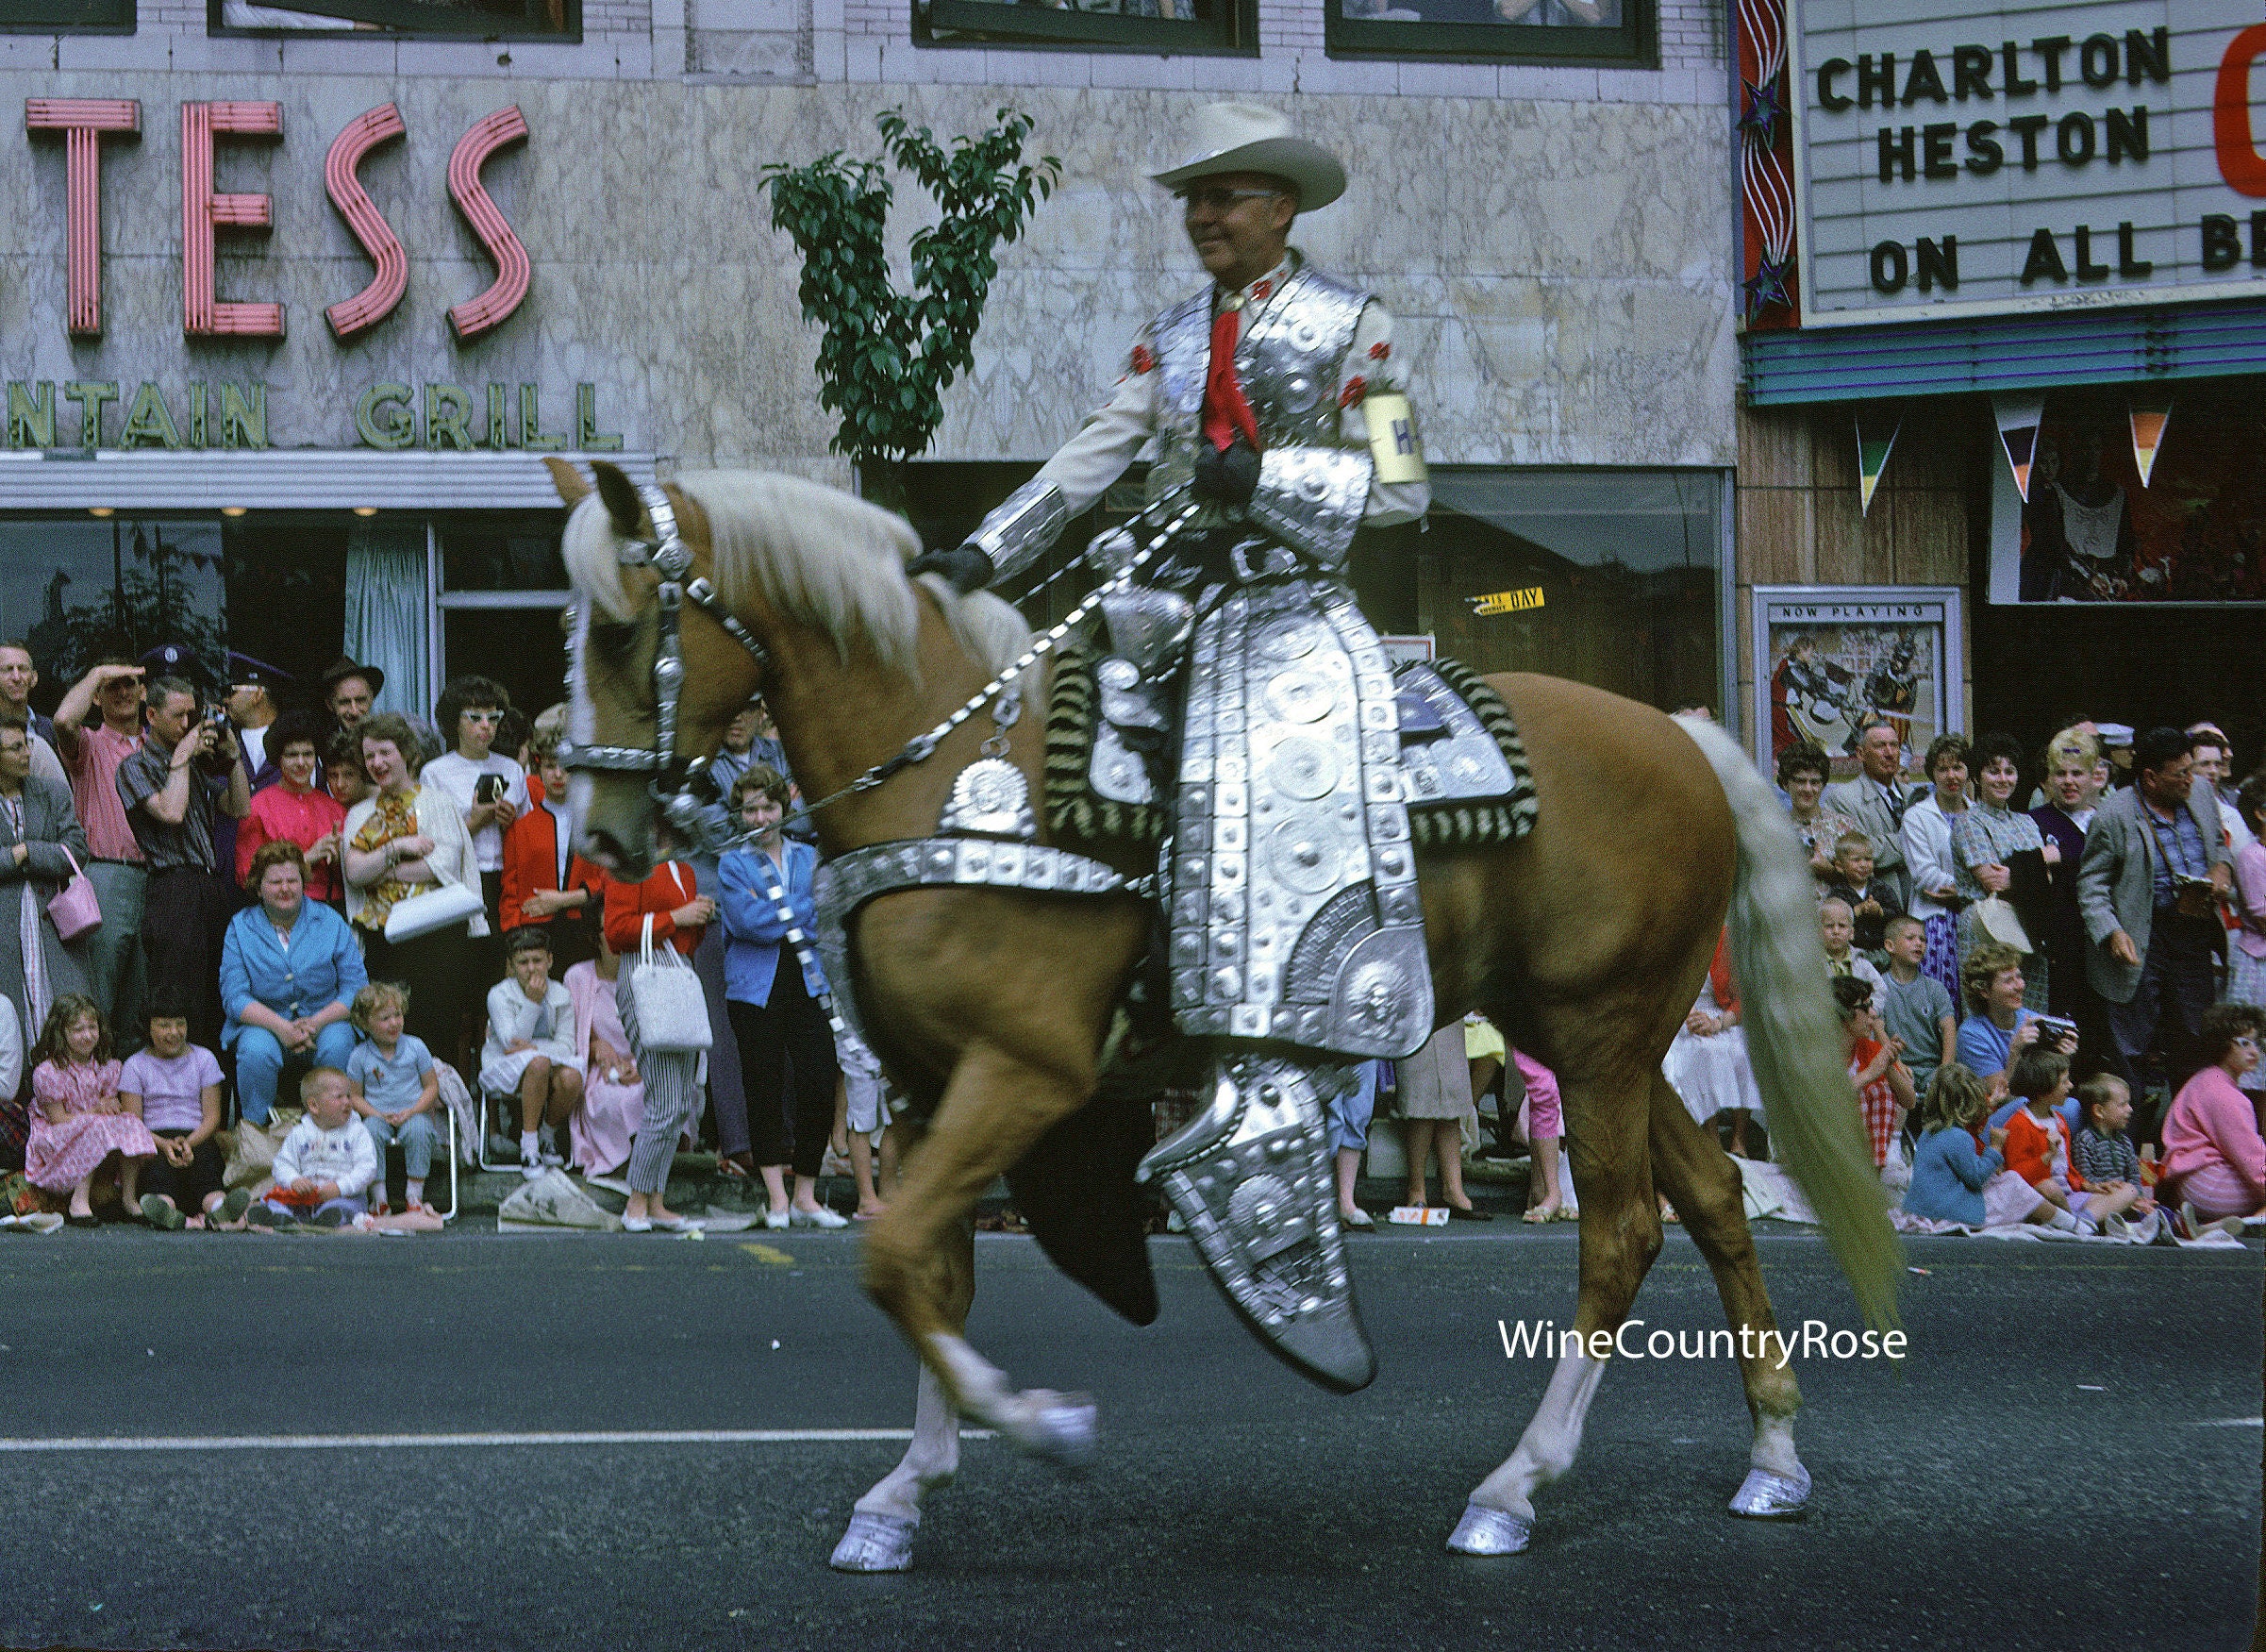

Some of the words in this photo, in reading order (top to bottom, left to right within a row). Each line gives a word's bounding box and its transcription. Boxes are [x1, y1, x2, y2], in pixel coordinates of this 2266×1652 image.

[1817, 25, 2170, 112] CHARLTON
[1878, 106, 2149, 183] HESTON
[25, 97, 531, 338] TESS
[1870, 235, 1958, 293] ON
[2020, 222, 2152, 285] ALL
[8, 380, 270, 450] NTAIN
[356, 381, 624, 451] GRILL
[1509, 588, 1537, 609] DAY
[1783, 606, 1817, 617] NOW
[1832, 605, 1924, 617] PLAYING
